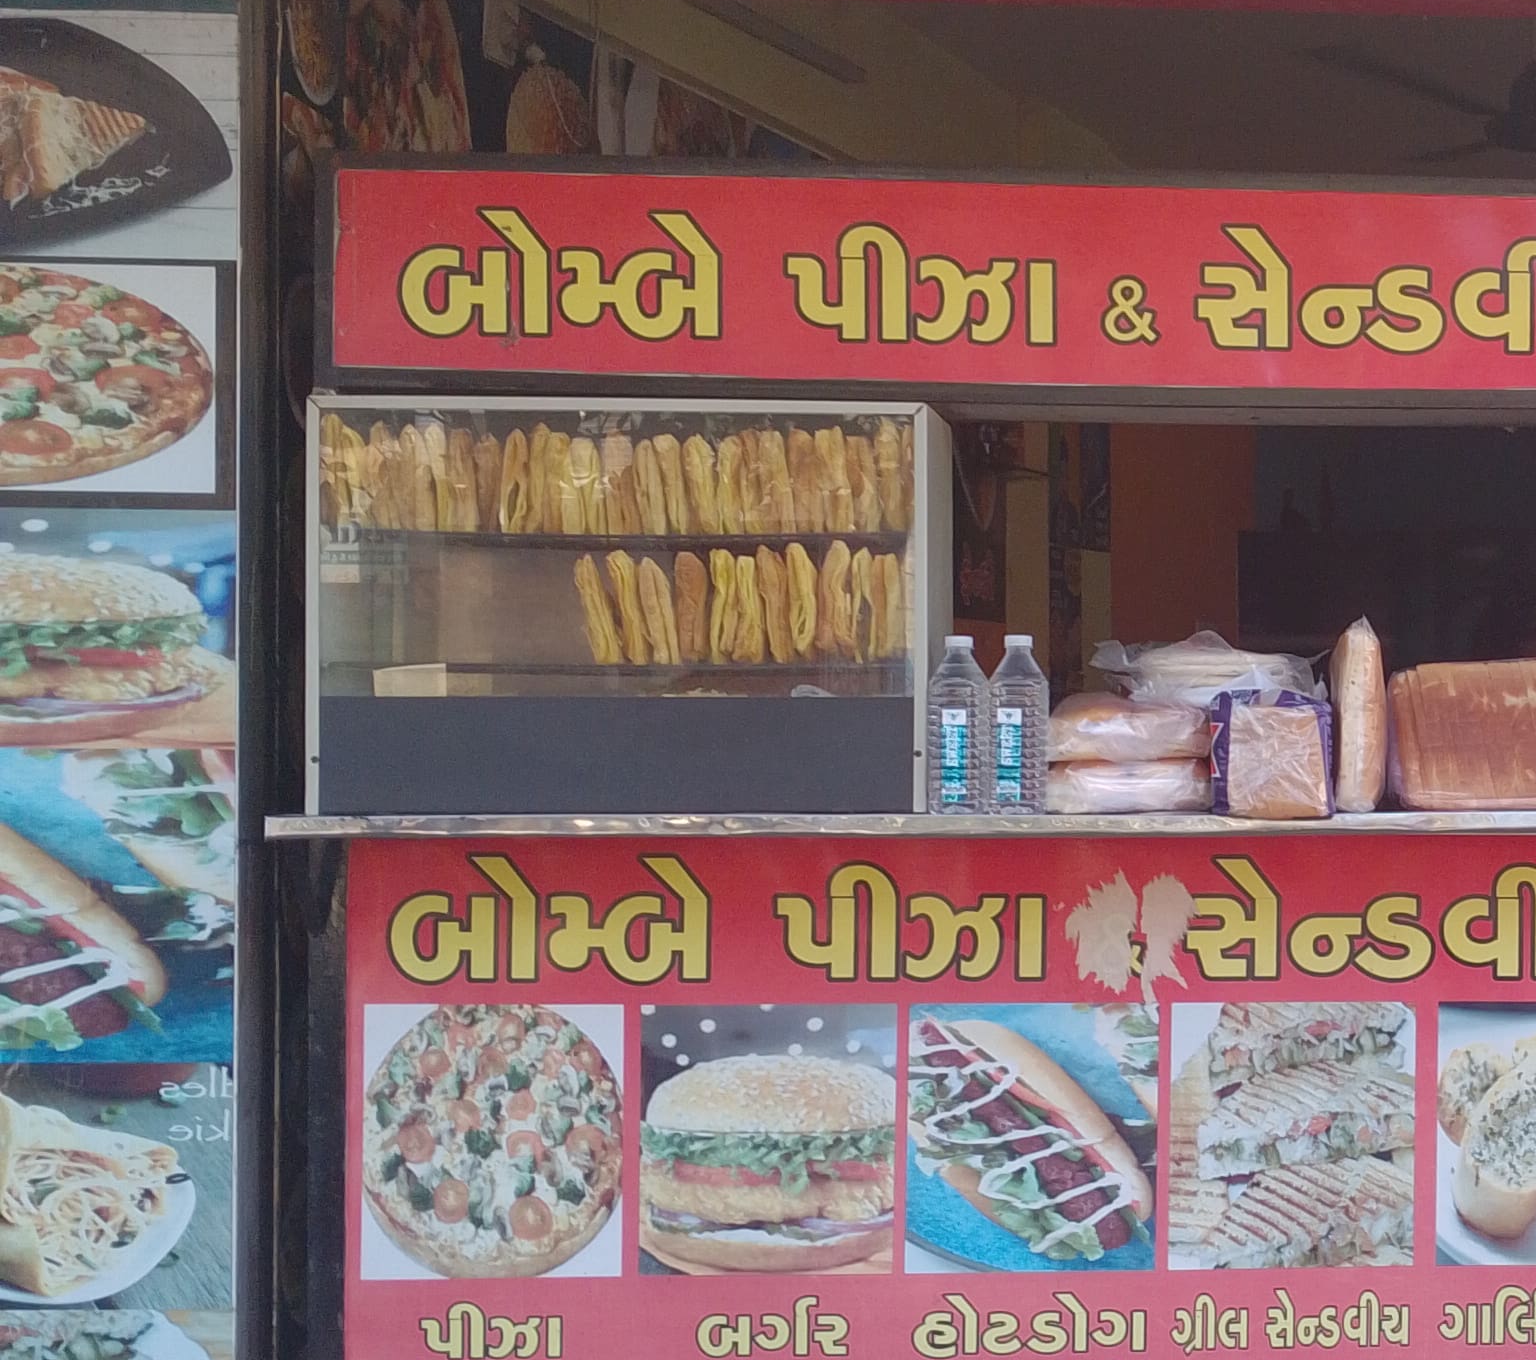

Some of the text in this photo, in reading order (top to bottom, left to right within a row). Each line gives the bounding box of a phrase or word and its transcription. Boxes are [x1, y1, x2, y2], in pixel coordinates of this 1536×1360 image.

[399, 206, 722, 340] બોમ્બે
[784, 222, 1056, 347] પીઝા
[1102, 275, 1159, 346] &
[388, 852, 711, 986] બોમ્બે
[773, 861, 1046, 982] પીઝા
[420, 1302, 563, 1360] પીઝા
[695, 1297, 850, 1358] બર્ગર
[911, 1291, 1148, 1360] હોટડોગ
[1170, 1288, 1410, 1356] ગ્રીલ સેન્ડવીચ
